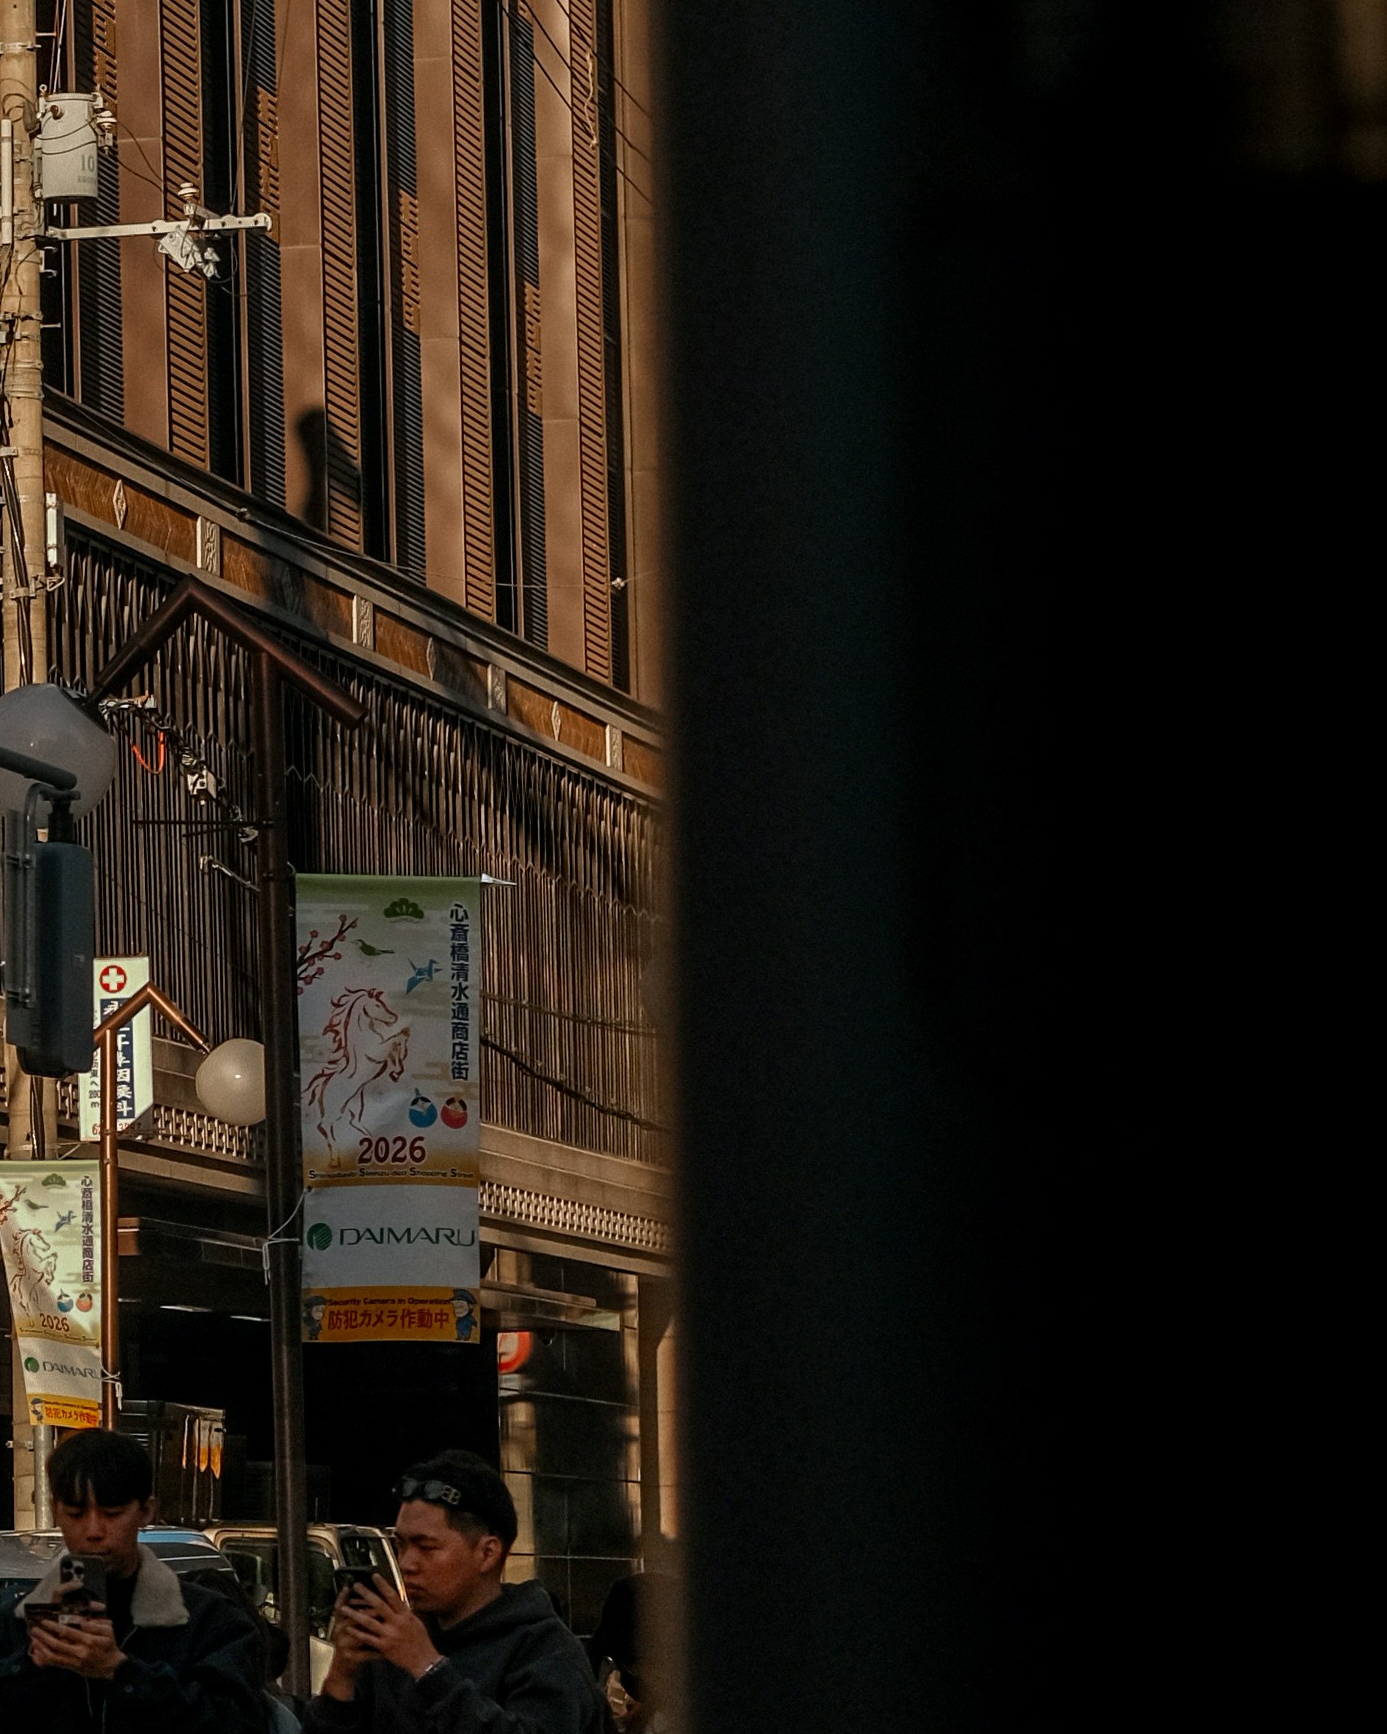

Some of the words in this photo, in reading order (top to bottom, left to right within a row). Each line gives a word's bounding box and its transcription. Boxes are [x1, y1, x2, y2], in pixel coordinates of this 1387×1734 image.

[449, 903, 469, 1081] 心斎橋清水通商店街
[357, 1136, 426, 1164] 2026
[340, 1227, 475, 1247] DAIMARU
[40, 1313, 70, 1332] 2026
[328, 1308, 449, 1330] 防犯カメラ作動中
